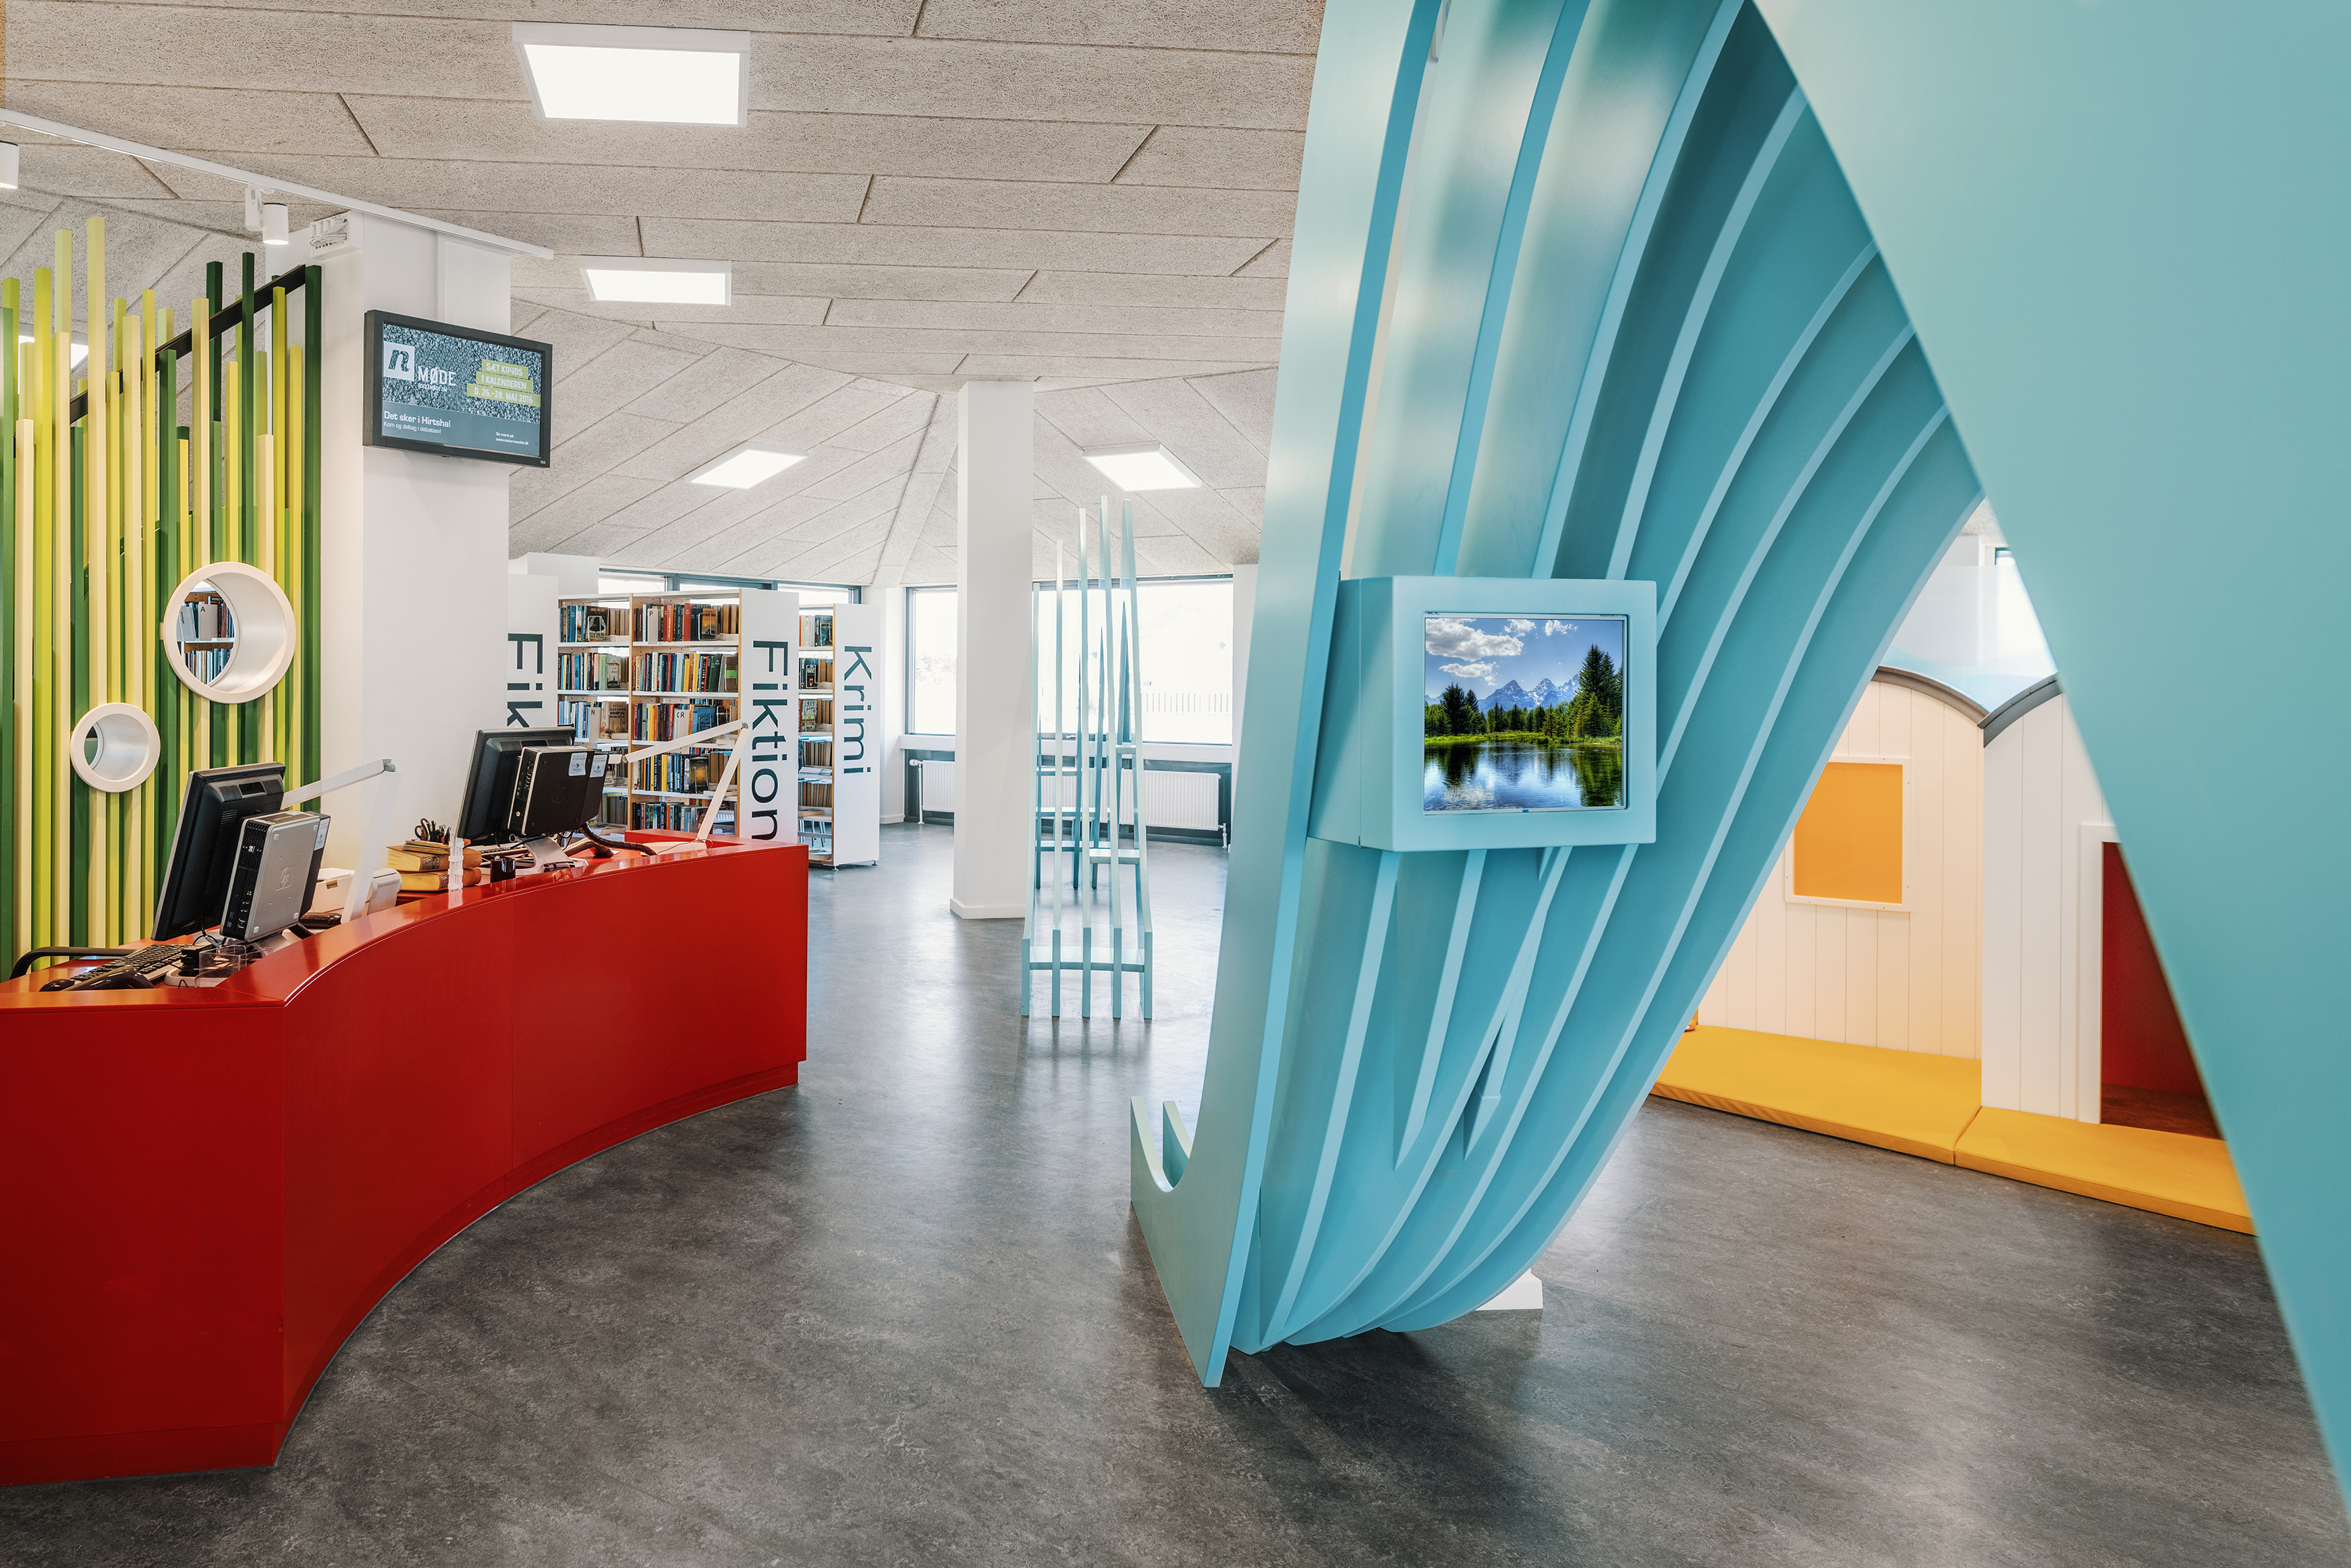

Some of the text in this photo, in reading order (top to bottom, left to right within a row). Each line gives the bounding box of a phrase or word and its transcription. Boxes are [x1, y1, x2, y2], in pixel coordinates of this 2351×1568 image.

[418, 365, 456, 386] MØDE
[486, 362, 523, 376] SÆT KRYDS
[486, 375, 526, 390] KALENDEREN
[474, 387, 480, 395] D.
[505, 392, 518, 401] MAJ
[519, 394, 534, 404] 2016
[384, 410, 398, 420] Det
[399, 414, 416, 422] sker
[418, 416, 420, 424] i
[402, 424, 417, 432] deltag
[420, 426, 441, 434] debatten!
[843, 646, 873, 774] Krimi
[751, 640, 789, 841] Fiktion
